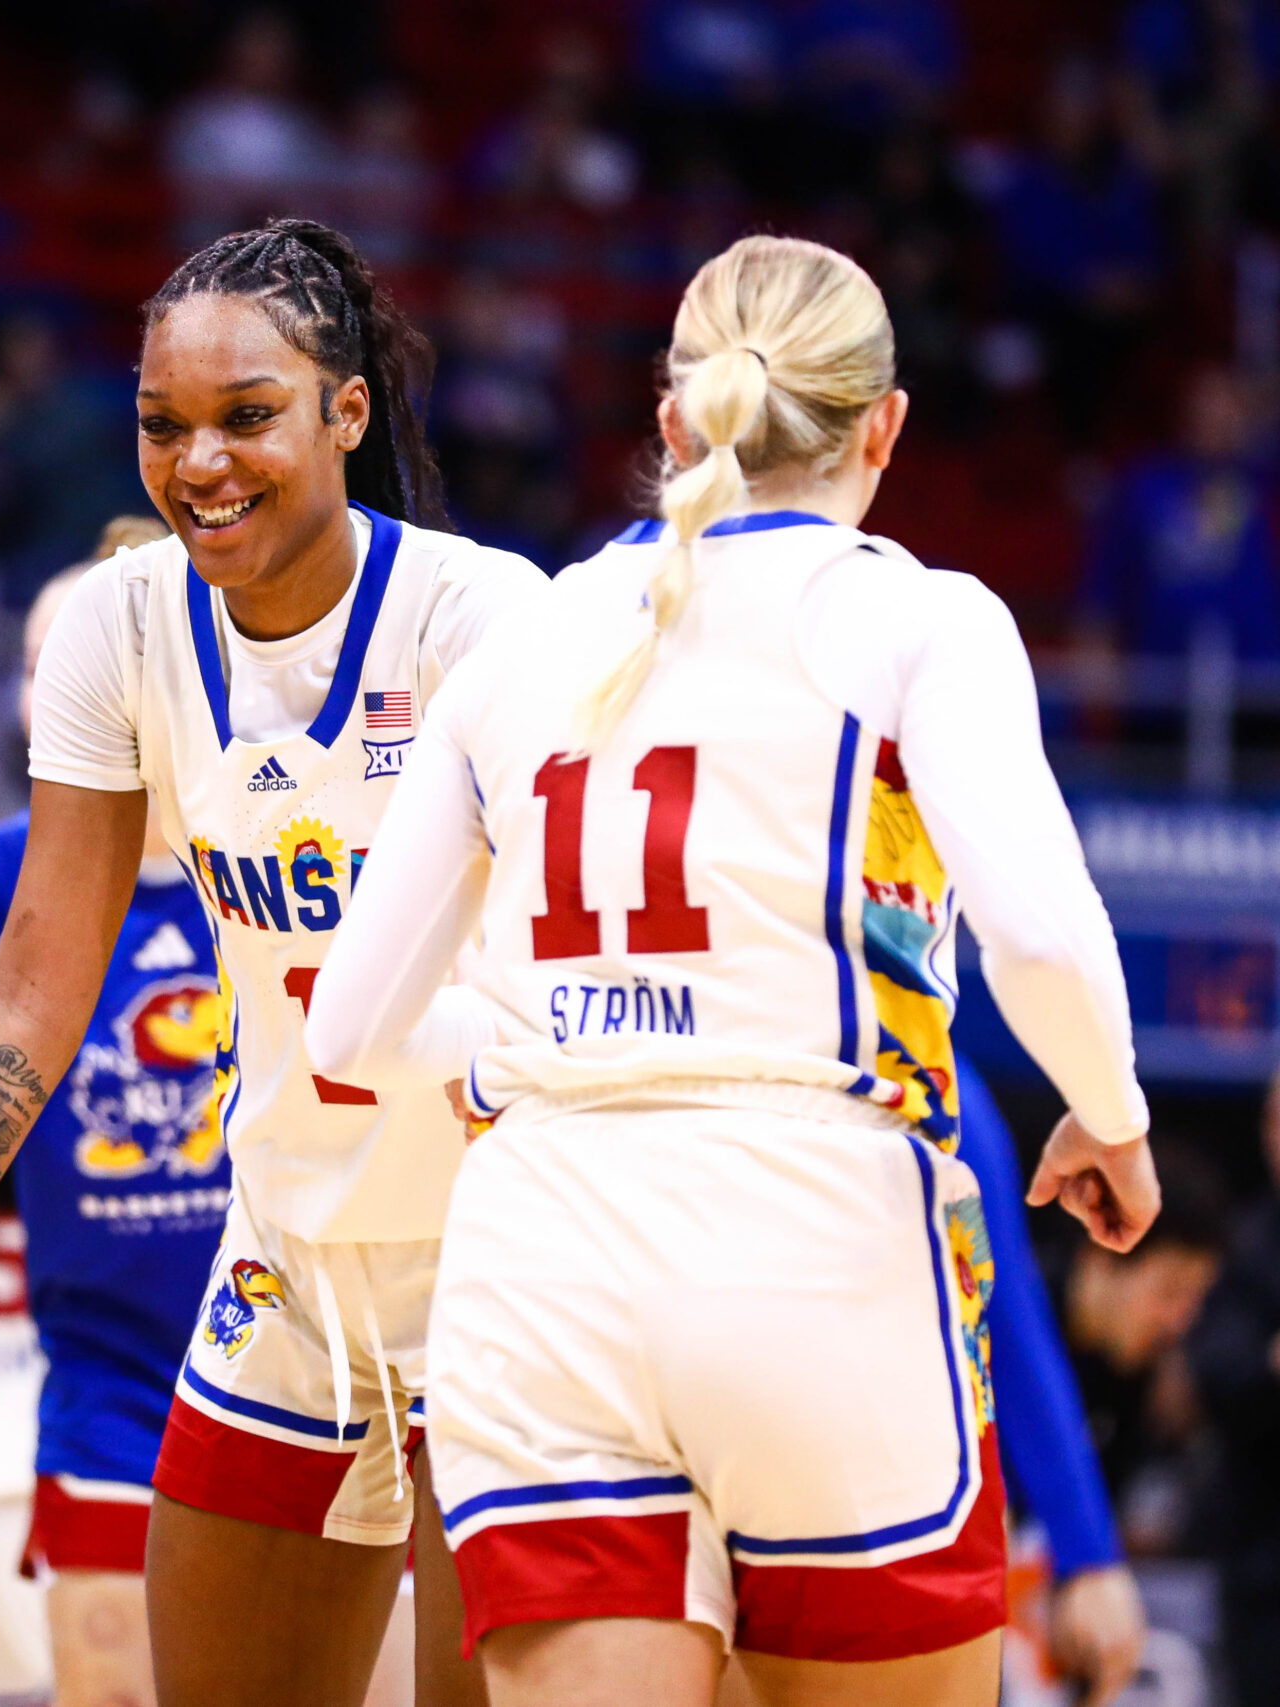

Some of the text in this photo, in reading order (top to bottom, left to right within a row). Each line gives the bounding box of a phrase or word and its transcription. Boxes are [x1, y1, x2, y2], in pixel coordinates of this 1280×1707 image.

[247, 777, 297, 792] adidas
[531, 745, 710, 960] 11
[190, 842, 370, 932] KANS
[551, 976, 695, 1044] STRÖM
[221, 1303, 245, 1329] KU
